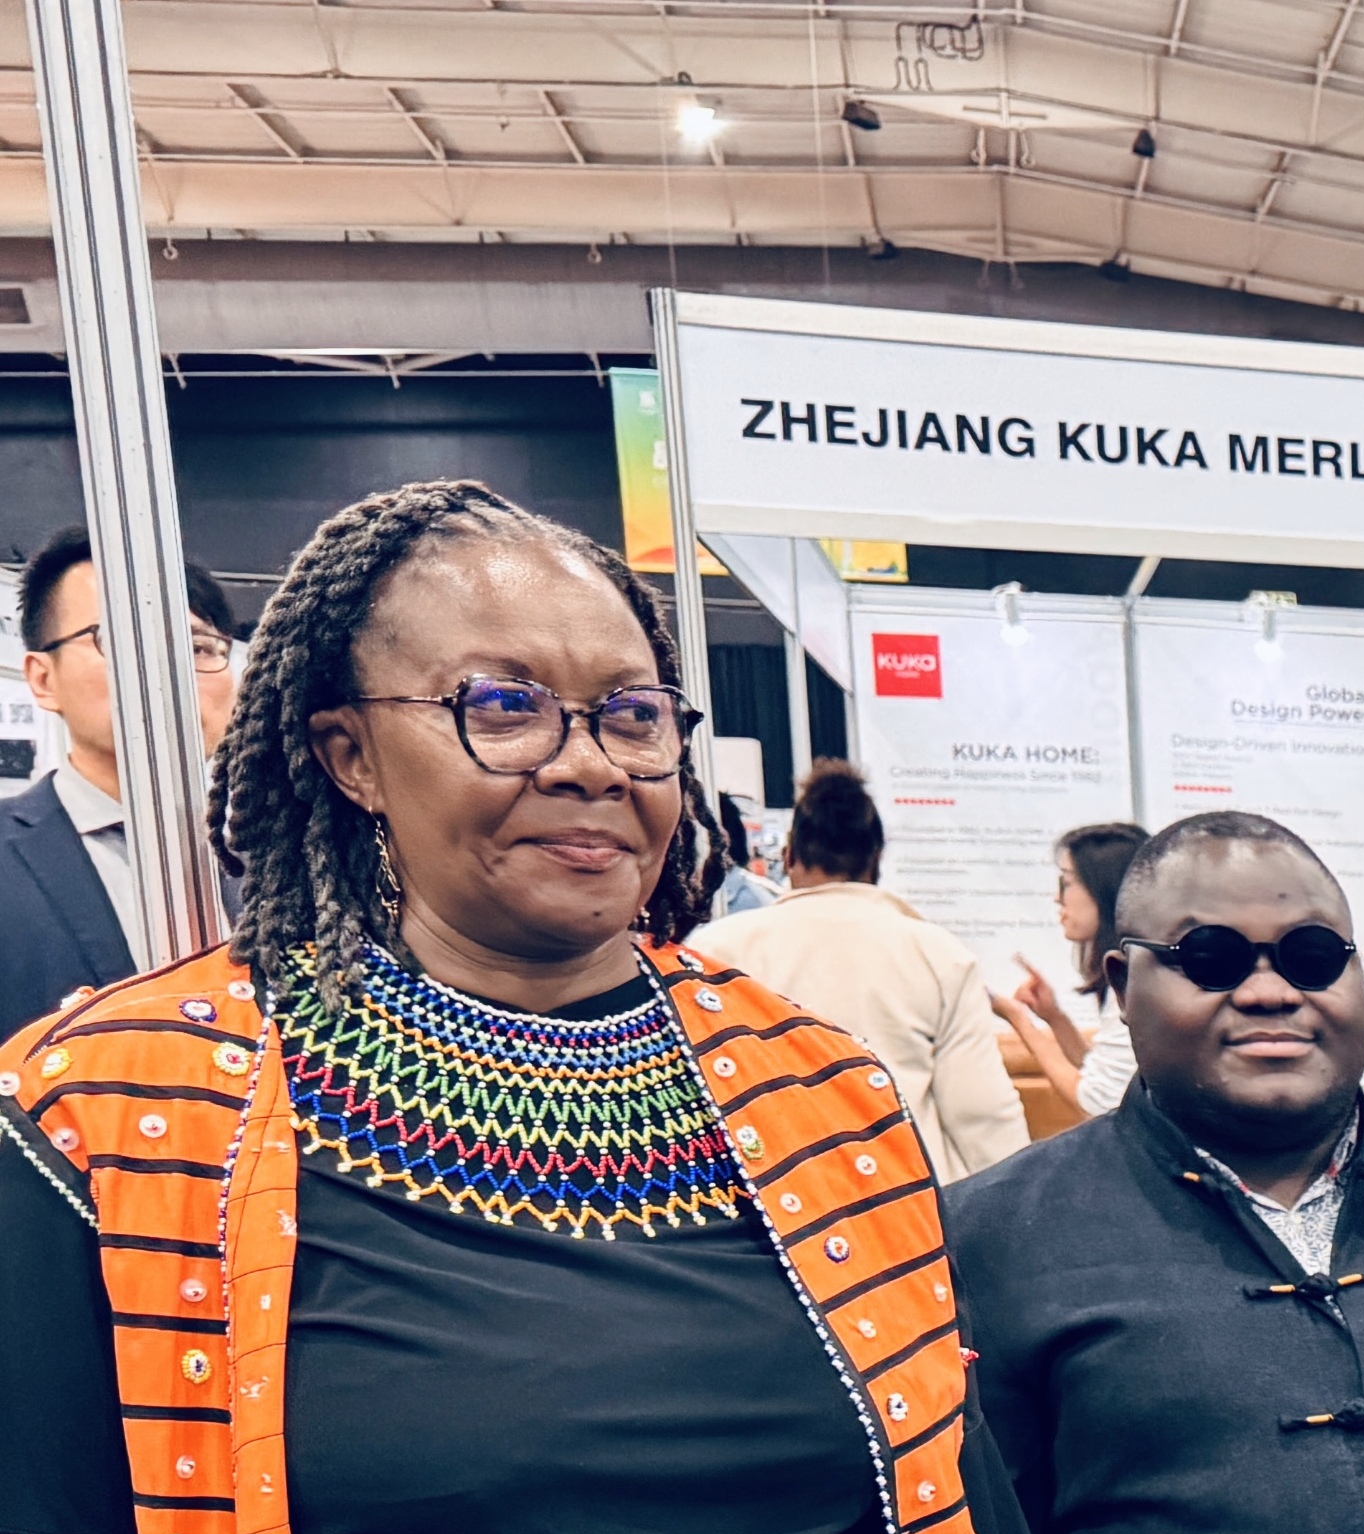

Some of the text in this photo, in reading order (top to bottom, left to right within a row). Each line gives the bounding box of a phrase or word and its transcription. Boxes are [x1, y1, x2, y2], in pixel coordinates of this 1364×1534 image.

[741, 398, 1036, 459] ZHEJIANG
[1058, 421, 1209, 470] KUKA
[1230, 699, 1303, 723] Design
[951, 742, 1101, 765] KUKA HOME:
[953, 768, 1027, 781] Happiness
